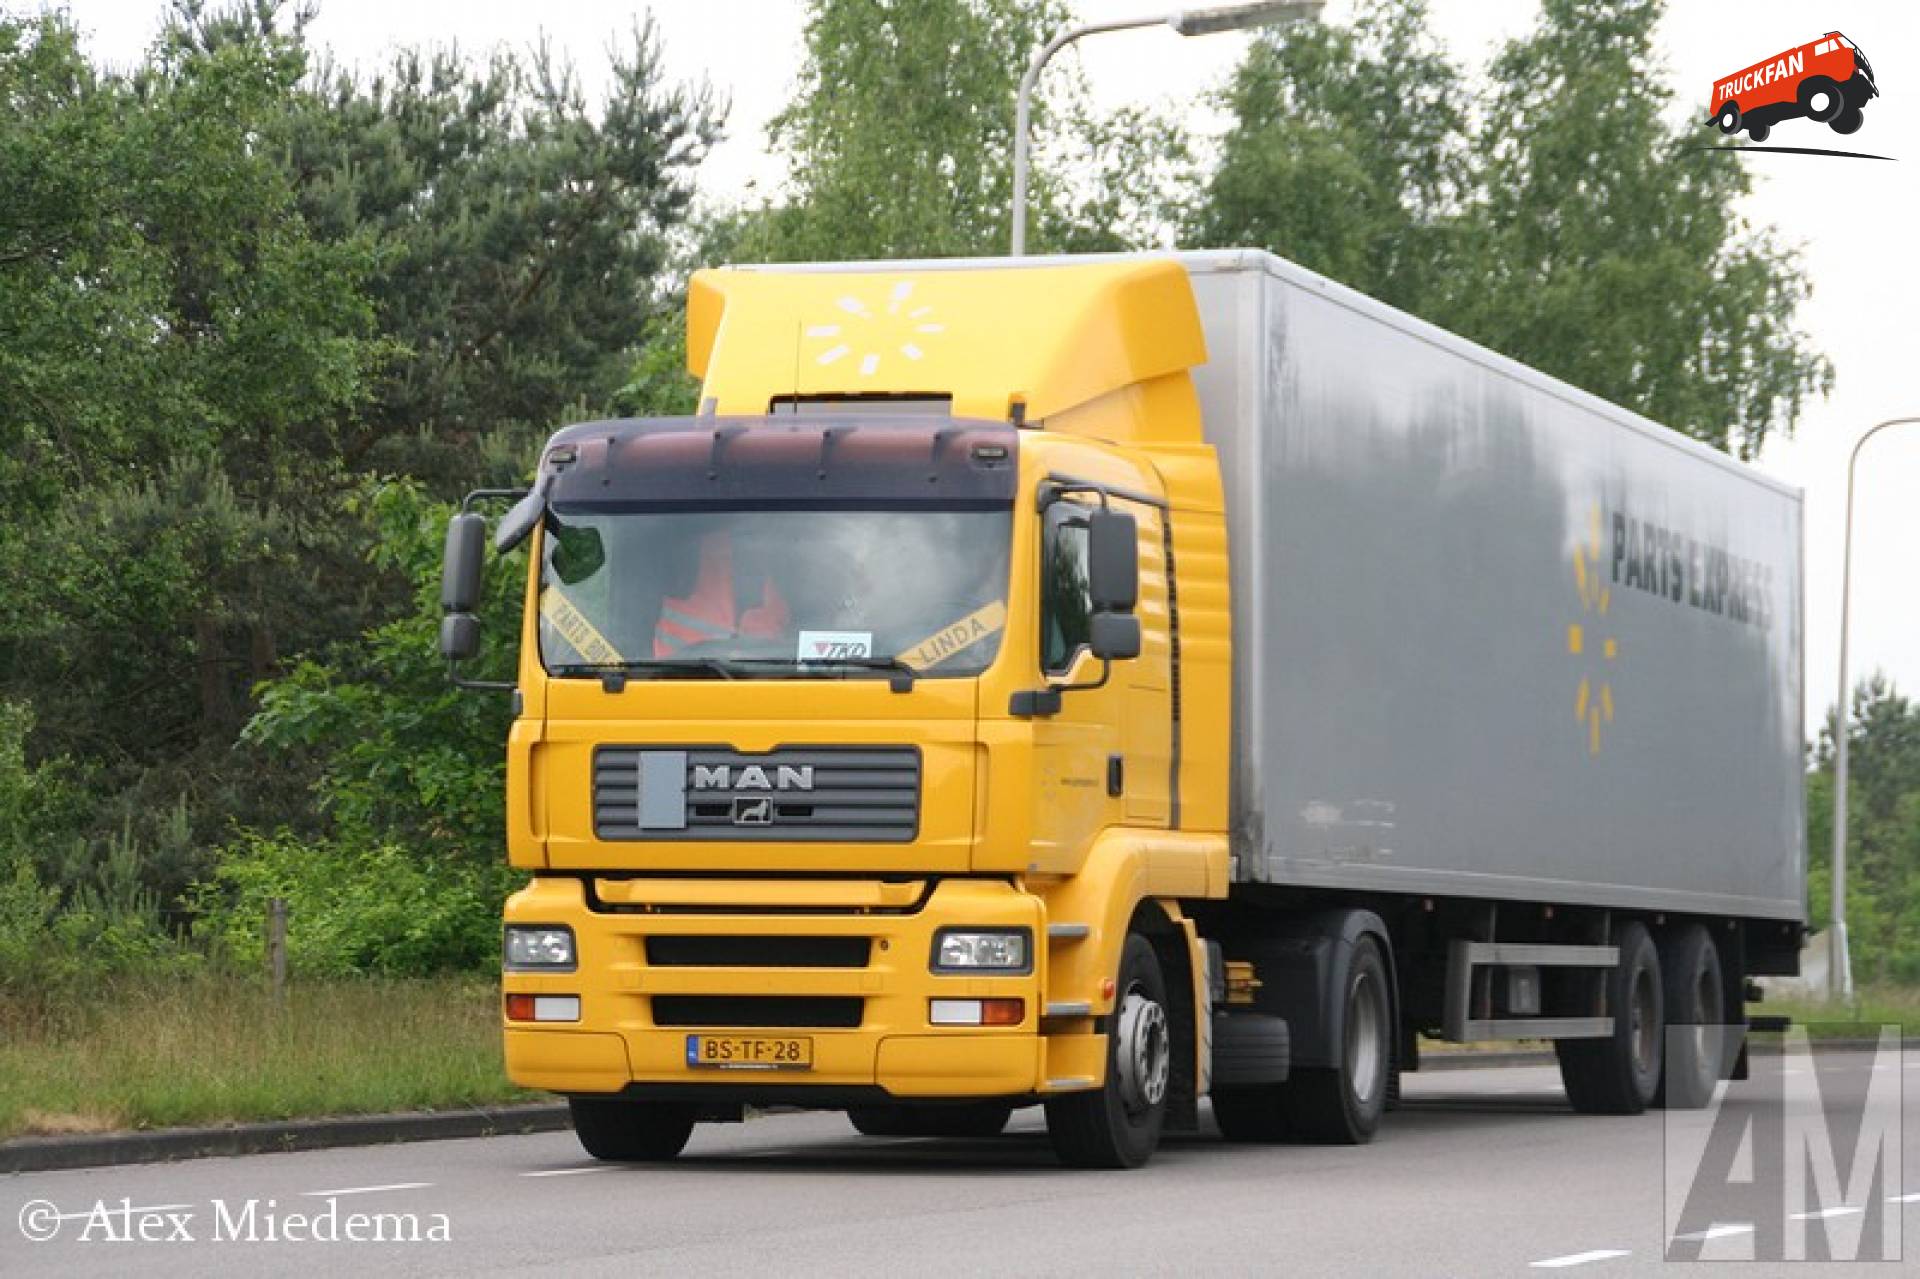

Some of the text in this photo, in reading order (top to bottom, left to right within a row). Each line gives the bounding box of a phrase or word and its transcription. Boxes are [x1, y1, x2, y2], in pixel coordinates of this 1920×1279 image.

[919, 617, 986, 664] LINDA
[695, 765, 813, 789] MAN
[705, 1040, 800, 1061] BS-TF-28
